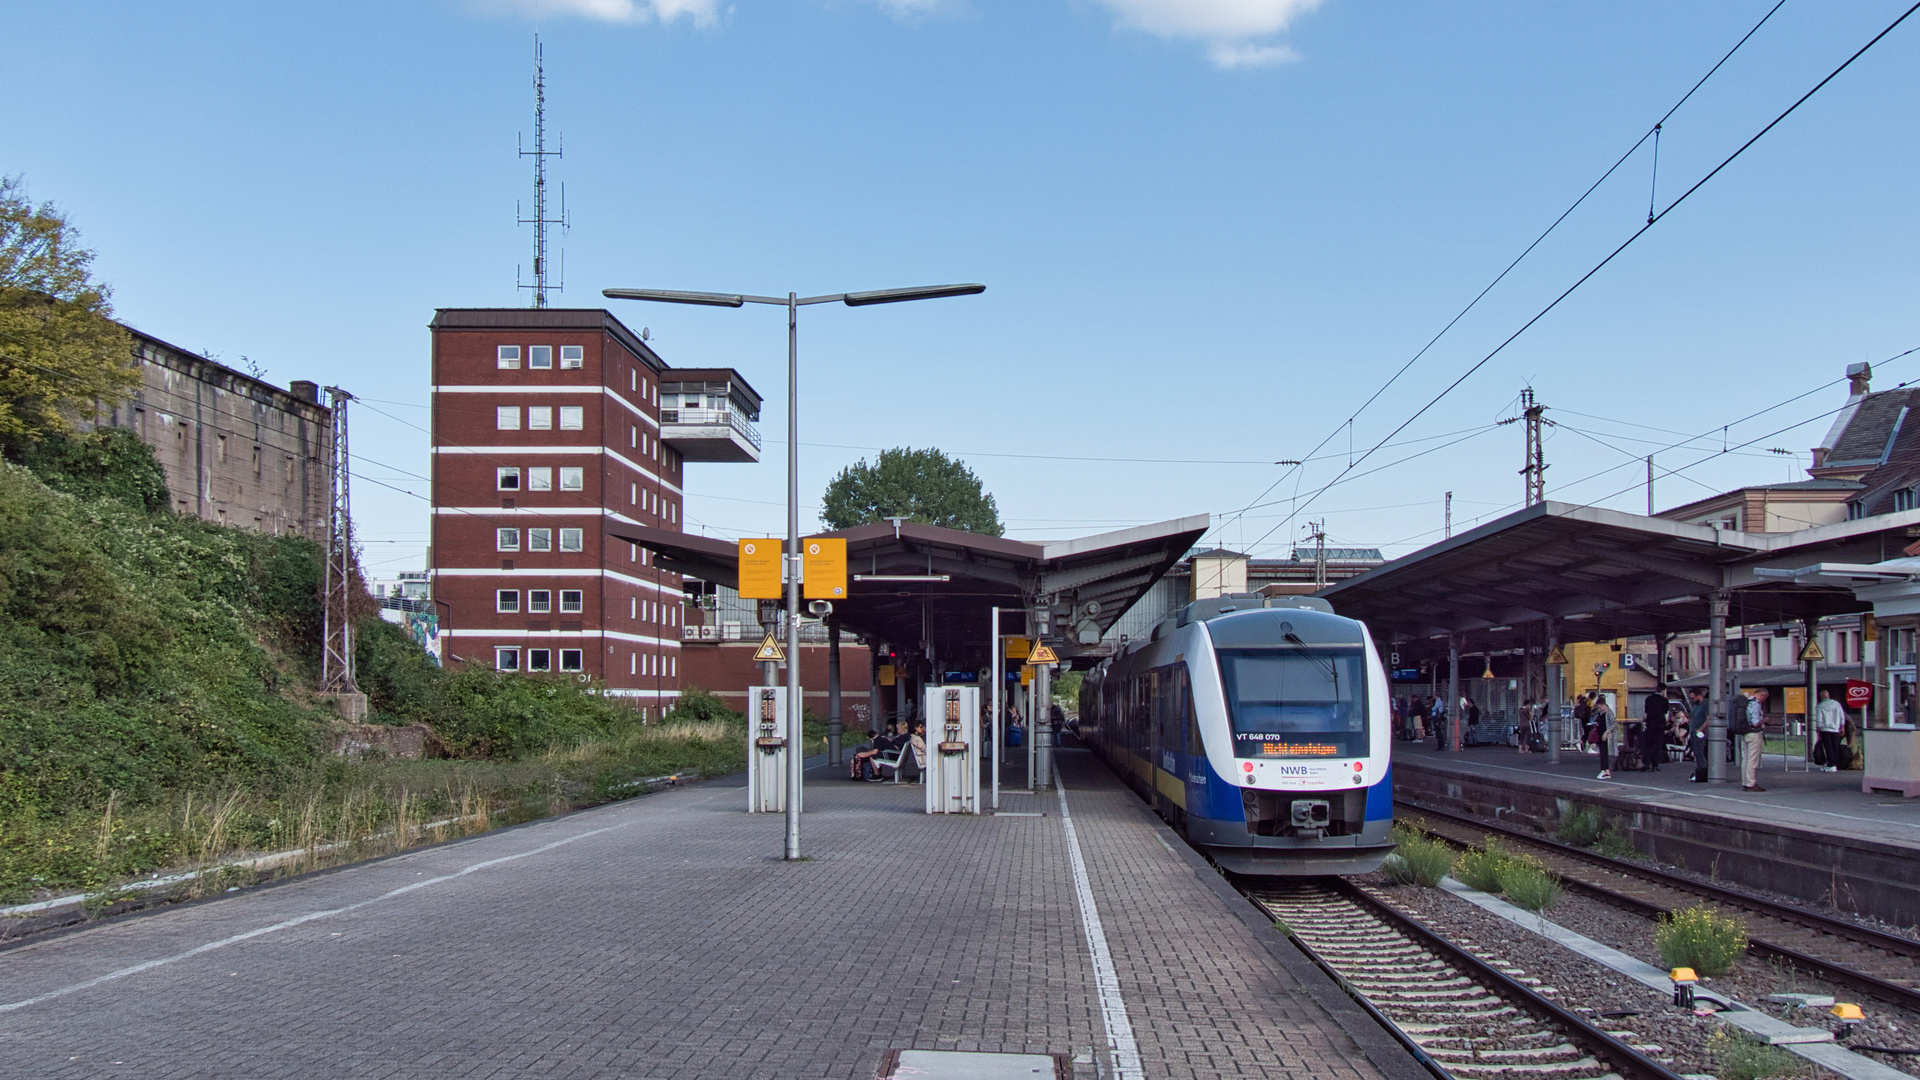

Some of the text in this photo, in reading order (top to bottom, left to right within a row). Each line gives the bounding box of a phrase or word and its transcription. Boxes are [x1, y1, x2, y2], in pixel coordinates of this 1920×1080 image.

[1391, 652, 1400, 665] B
[1624, 654, 1634, 666] B
[1236, 733, 1280, 741] VT 648 070
[1264, 743, 1336, 755] Nicht einsteigen
[1280, 766, 1308, 775] NWB
